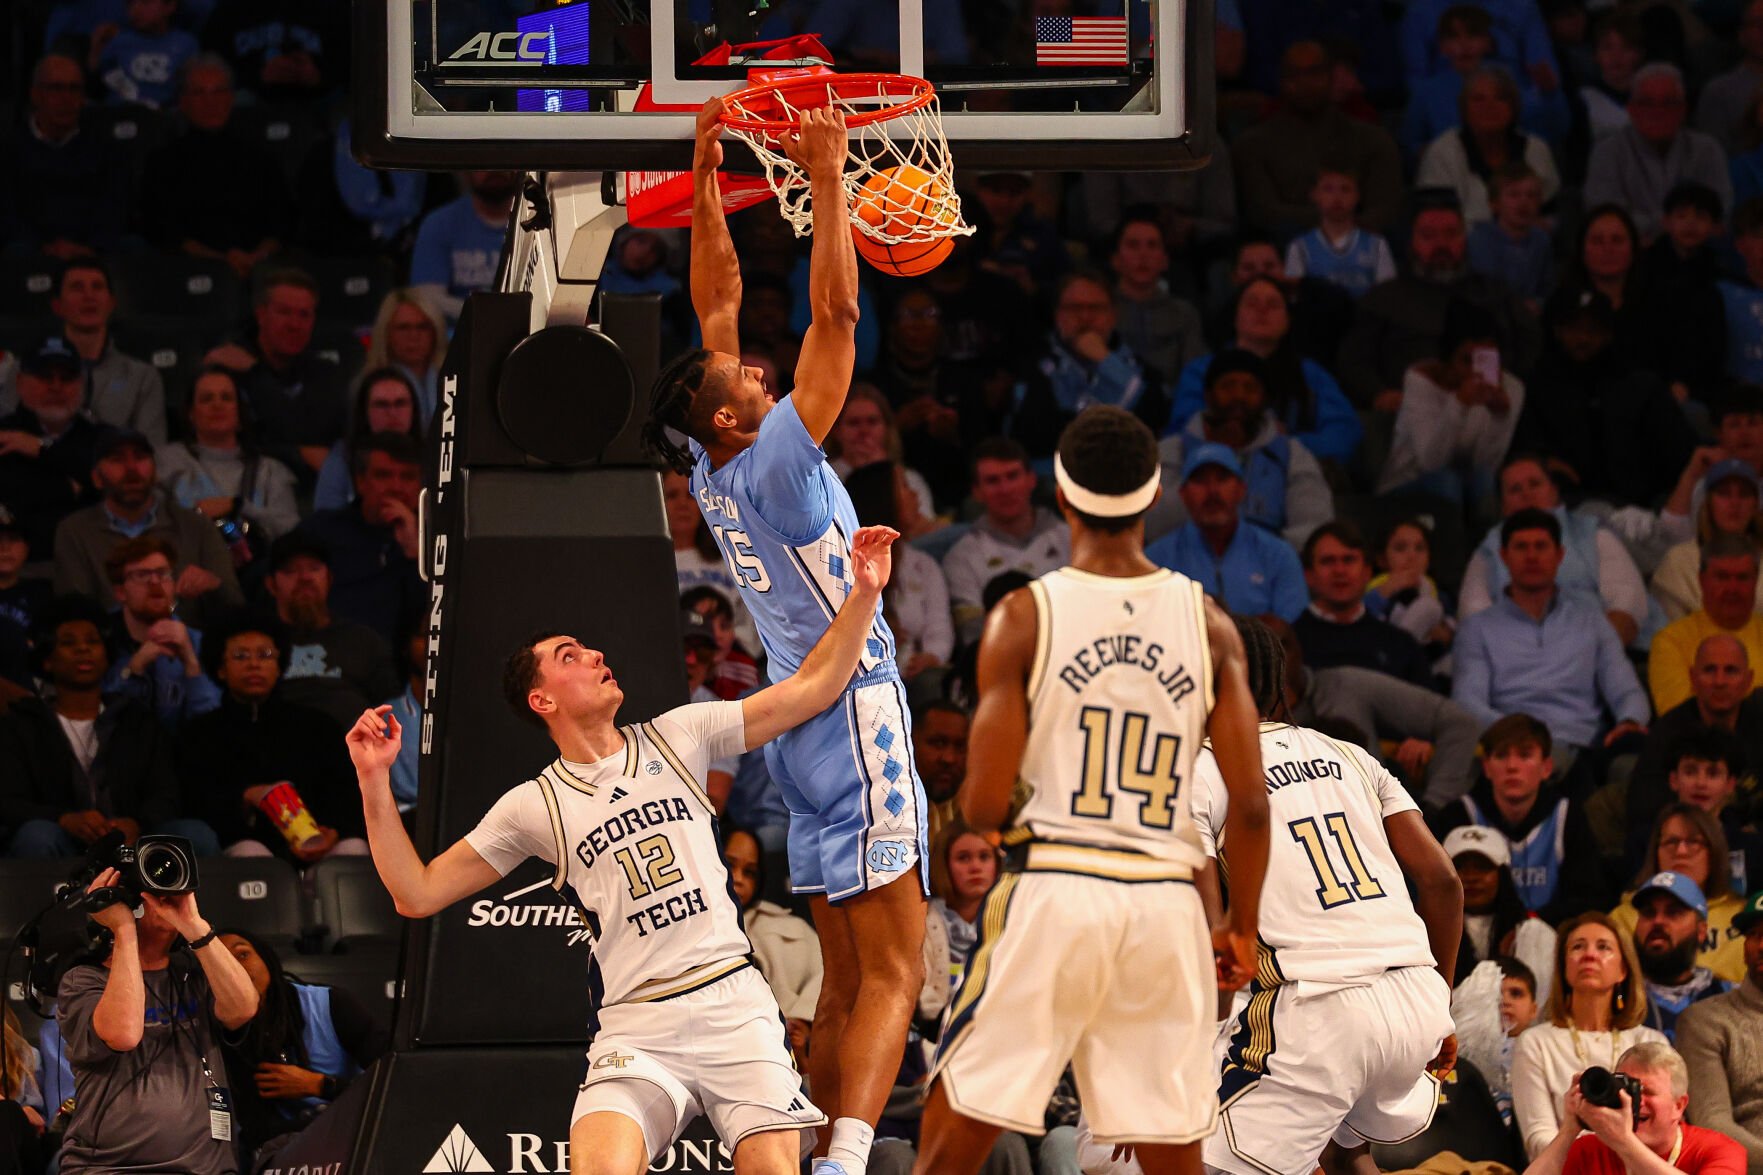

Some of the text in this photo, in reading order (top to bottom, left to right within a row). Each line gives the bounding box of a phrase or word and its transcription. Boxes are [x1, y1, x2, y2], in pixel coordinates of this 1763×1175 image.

[447, 31, 550, 59] ACC
[712, 524, 772, 594] 15
[421, 533, 448, 755] STING
[1059, 635, 1164, 694] REEVES
[1071, 705, 1182, 831] 14
[575, 797, 694, 870] GEORGIA
[613, 833, 685, 902] 12
[1287, 811, 1388, 911] 11
[246, 883, 263, 898] 10
[466, 899, 585, 928] SOUTHE
[626, 888, 709, 938] TECH
